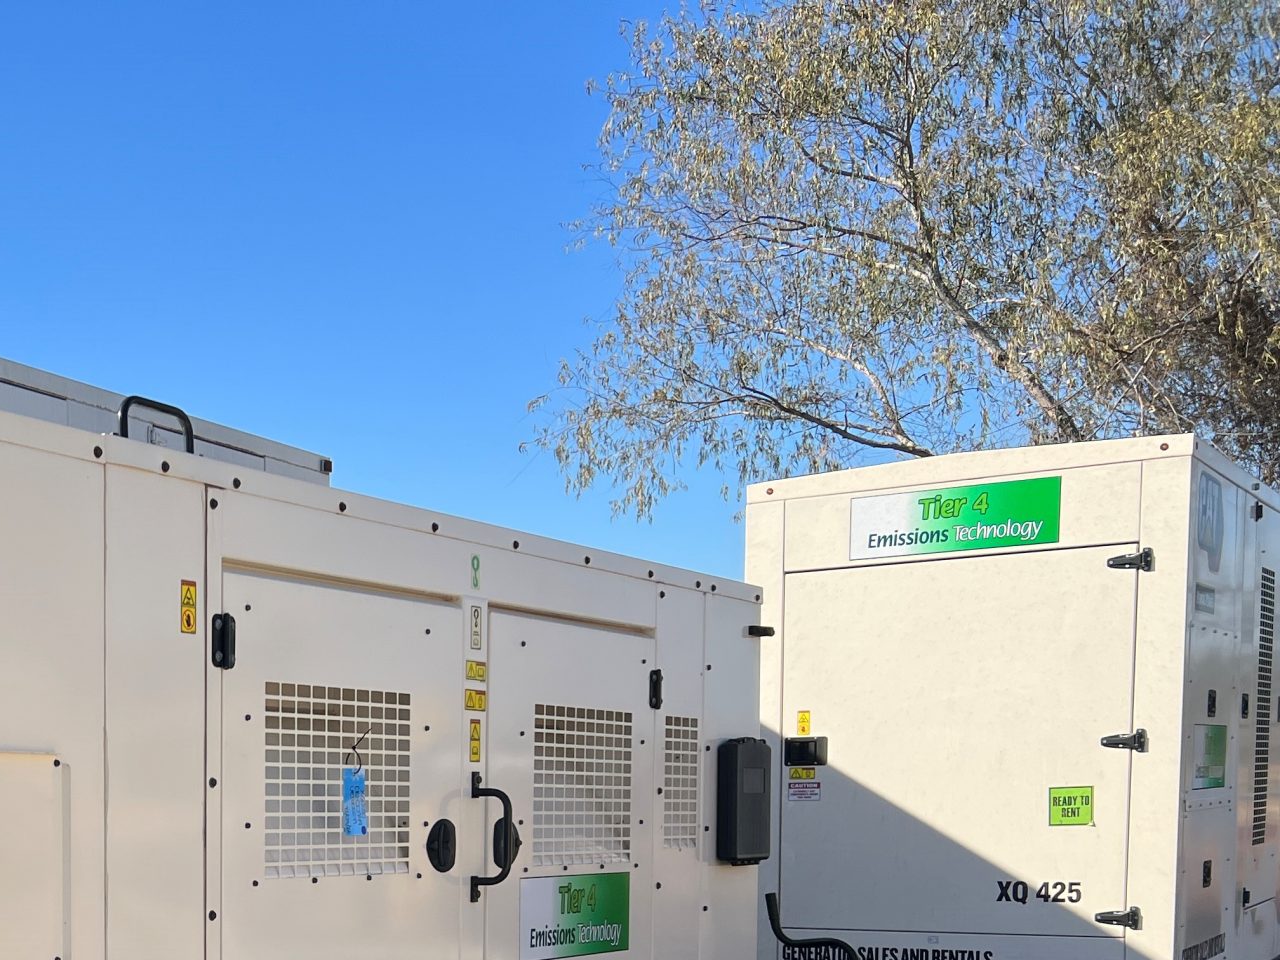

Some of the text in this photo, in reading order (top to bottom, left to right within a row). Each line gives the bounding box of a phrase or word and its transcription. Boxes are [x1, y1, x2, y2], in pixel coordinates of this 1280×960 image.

[918, 492, 990, 520] Tier 4
[868, 519, 1043, 548] Emissions Technology
[1052, 795, 1090, 807] READY TO
[1061, 807, 1080, 818] RENT
[559, 882, 596, 914] Tier 4
[996, 881, 1082, 905] XQ 425
[530, 920, 622, 948] Emissions Technology
